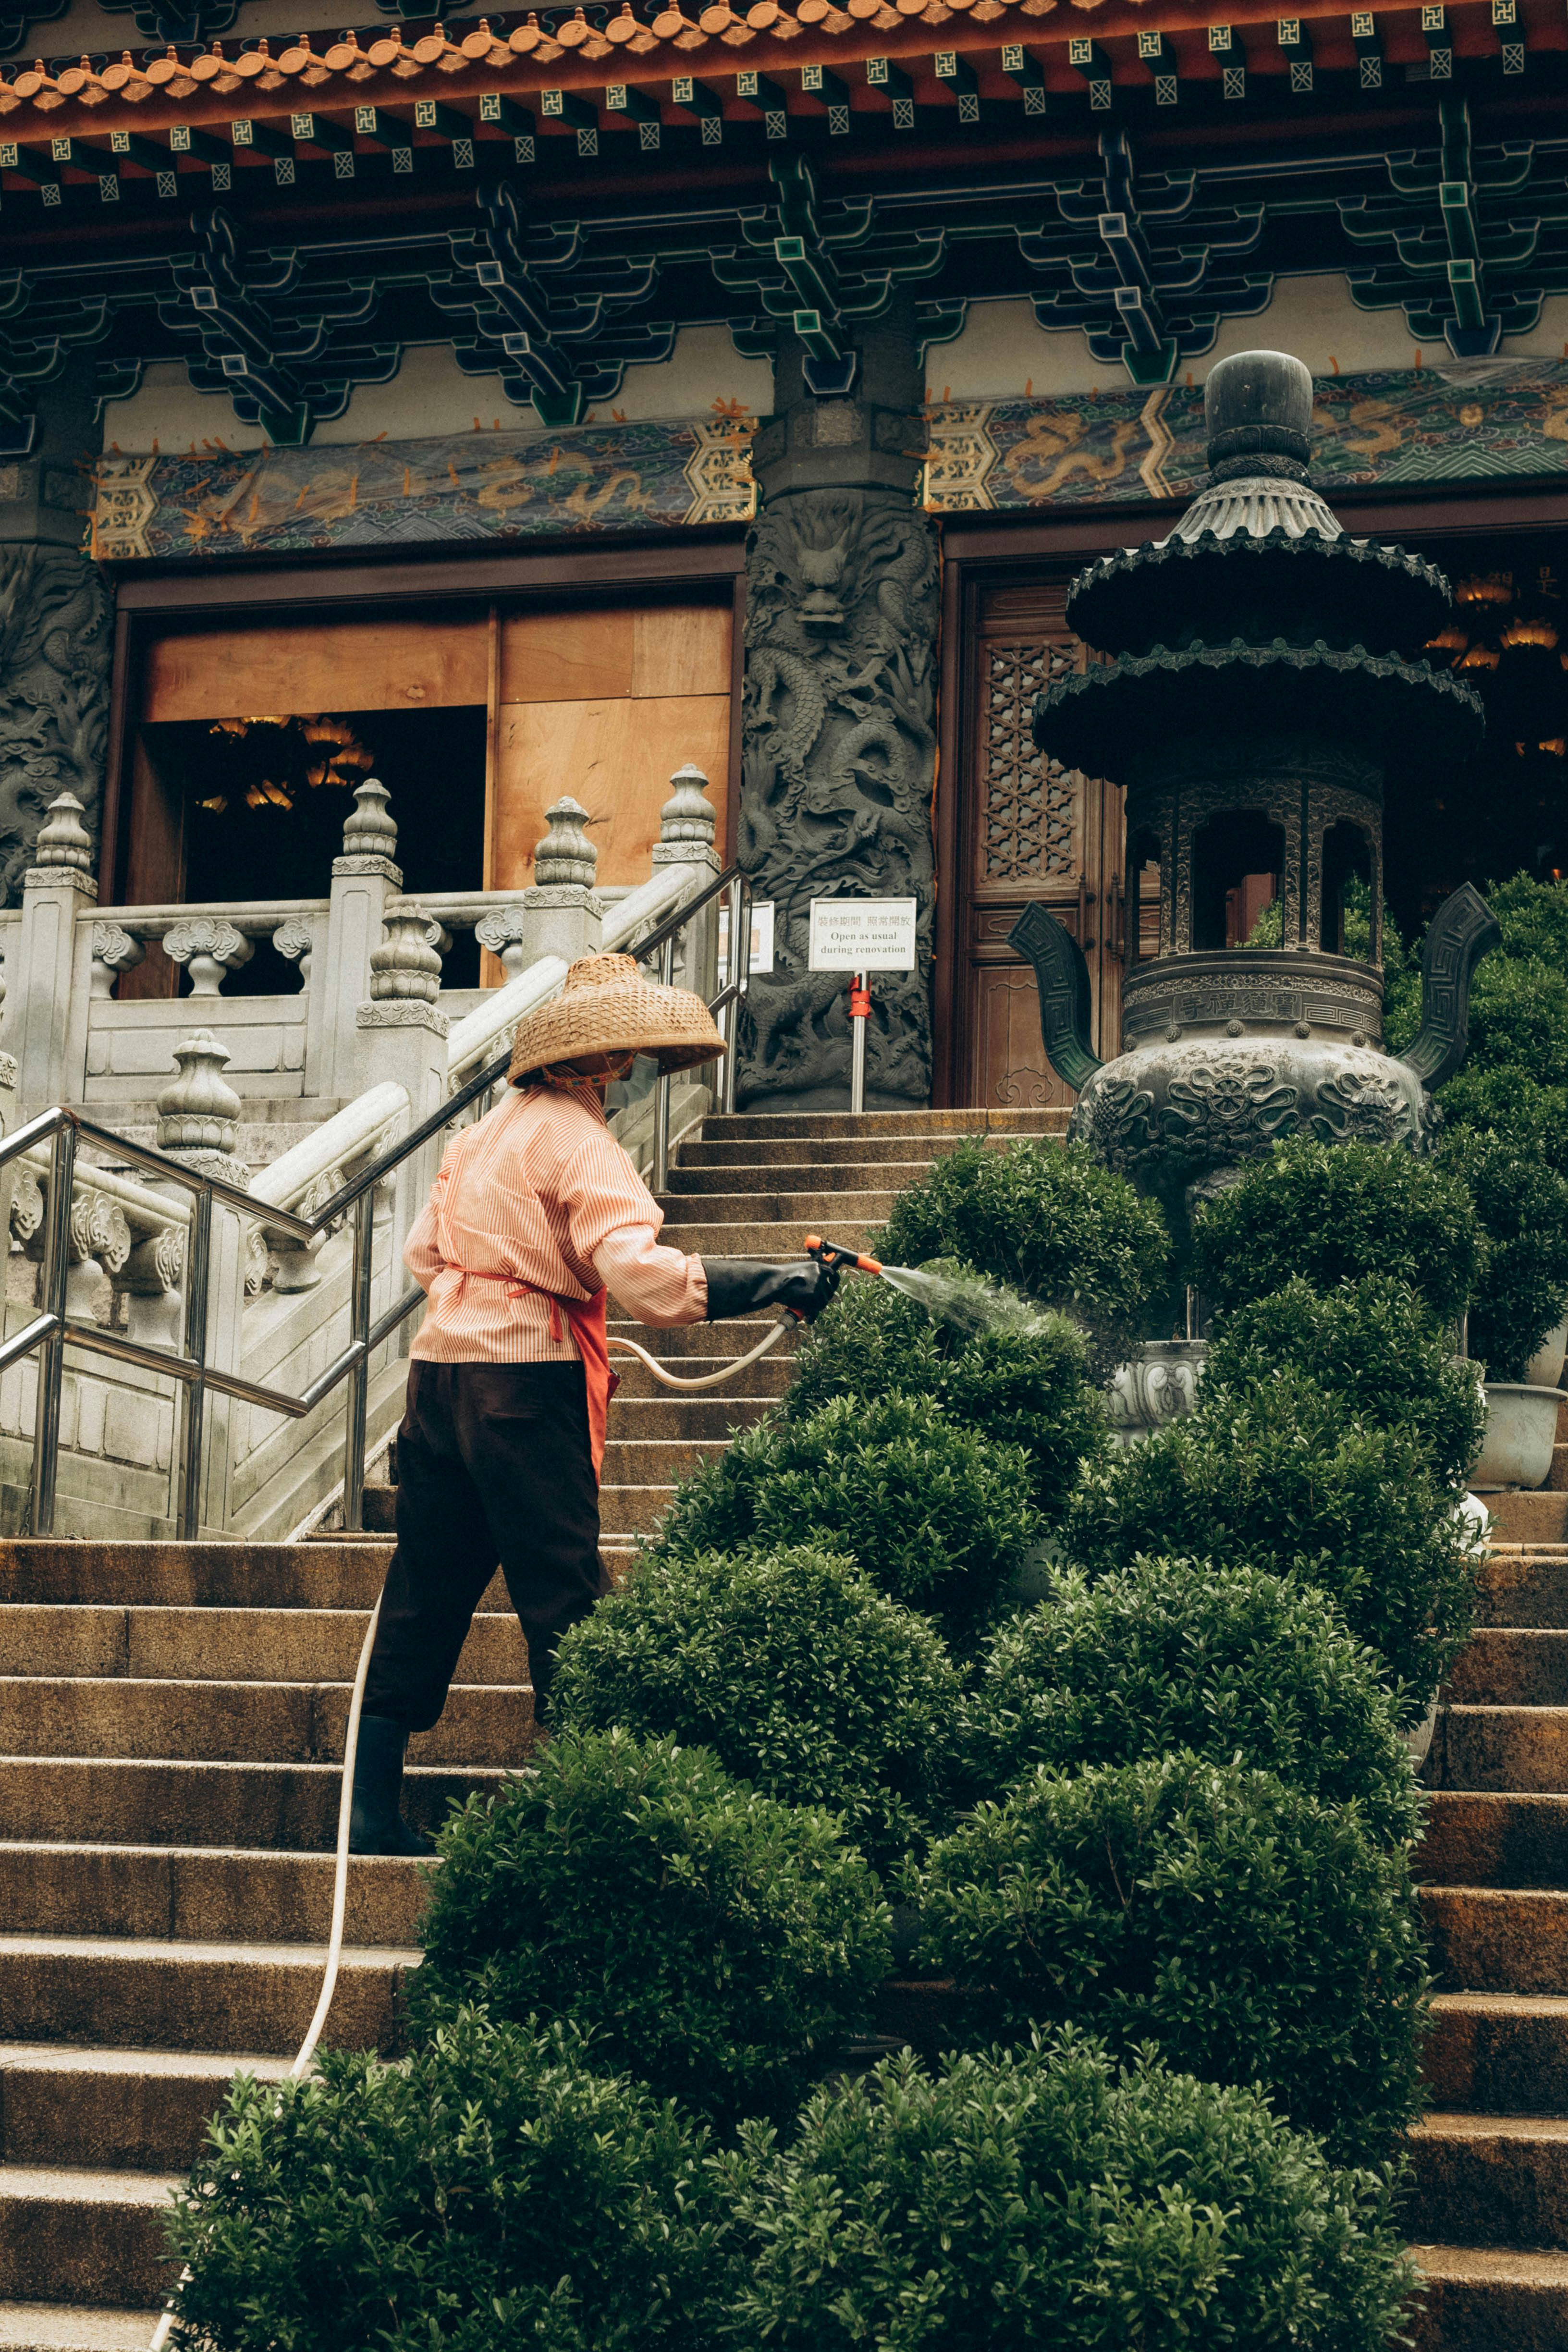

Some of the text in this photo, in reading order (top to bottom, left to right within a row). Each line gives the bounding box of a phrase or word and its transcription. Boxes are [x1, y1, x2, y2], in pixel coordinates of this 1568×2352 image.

[818, 916, 911, 927] 裝修期間 照常開放
[831, 932, 856, 942] Open
[872, 932, 896, 940] usual
[821, 945, 906, 955] during renovation
